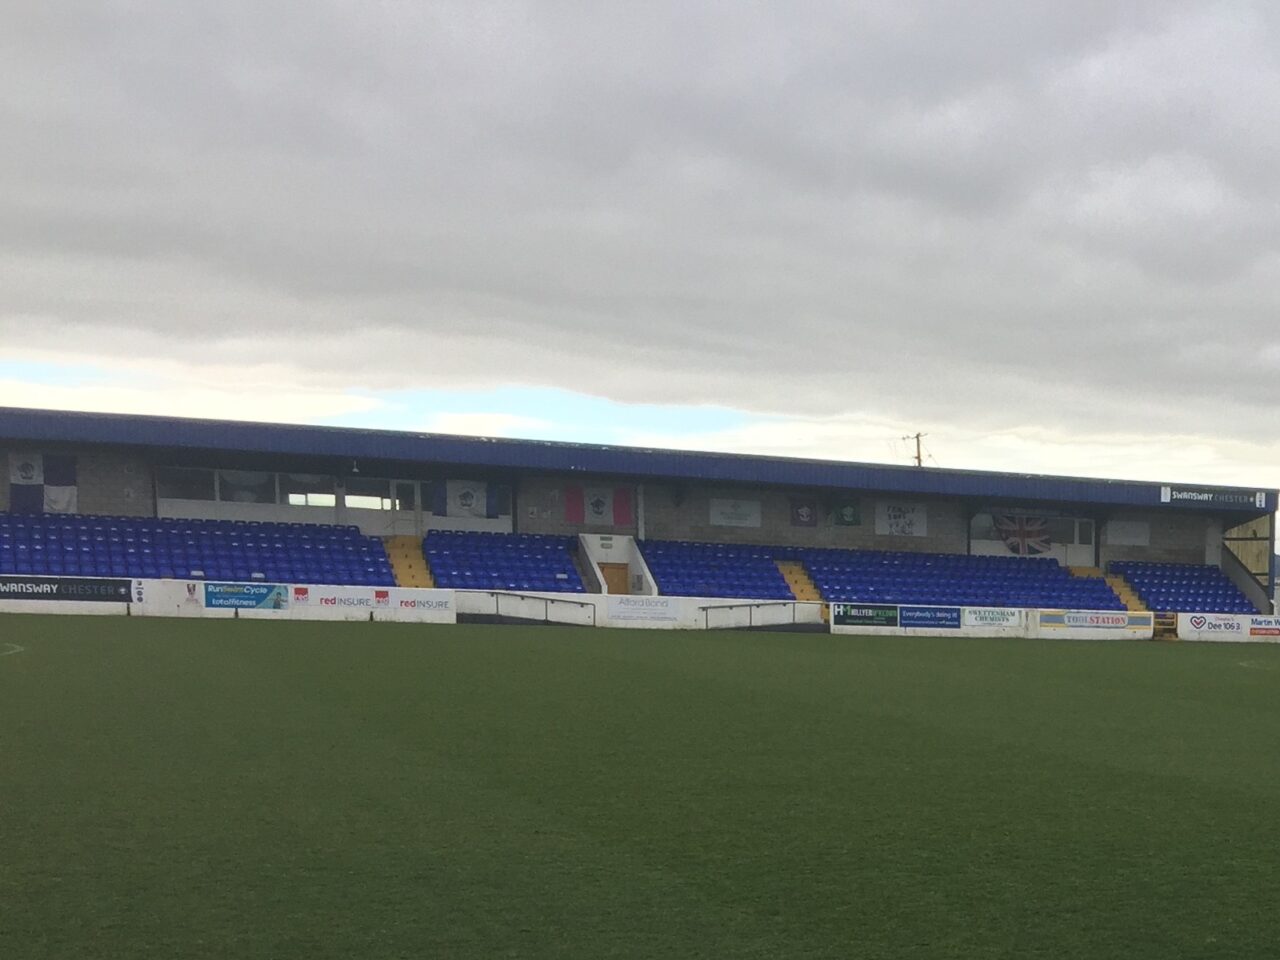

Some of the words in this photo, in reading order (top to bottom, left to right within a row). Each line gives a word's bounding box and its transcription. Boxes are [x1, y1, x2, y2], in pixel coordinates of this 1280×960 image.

[1172, 490, 1213, 501] SWANSWAY
[61, 584, 115, 595] CHESTER
[1207, 622, 1222, 631] Dee
[1251, 618, 1273, 626] Martin
